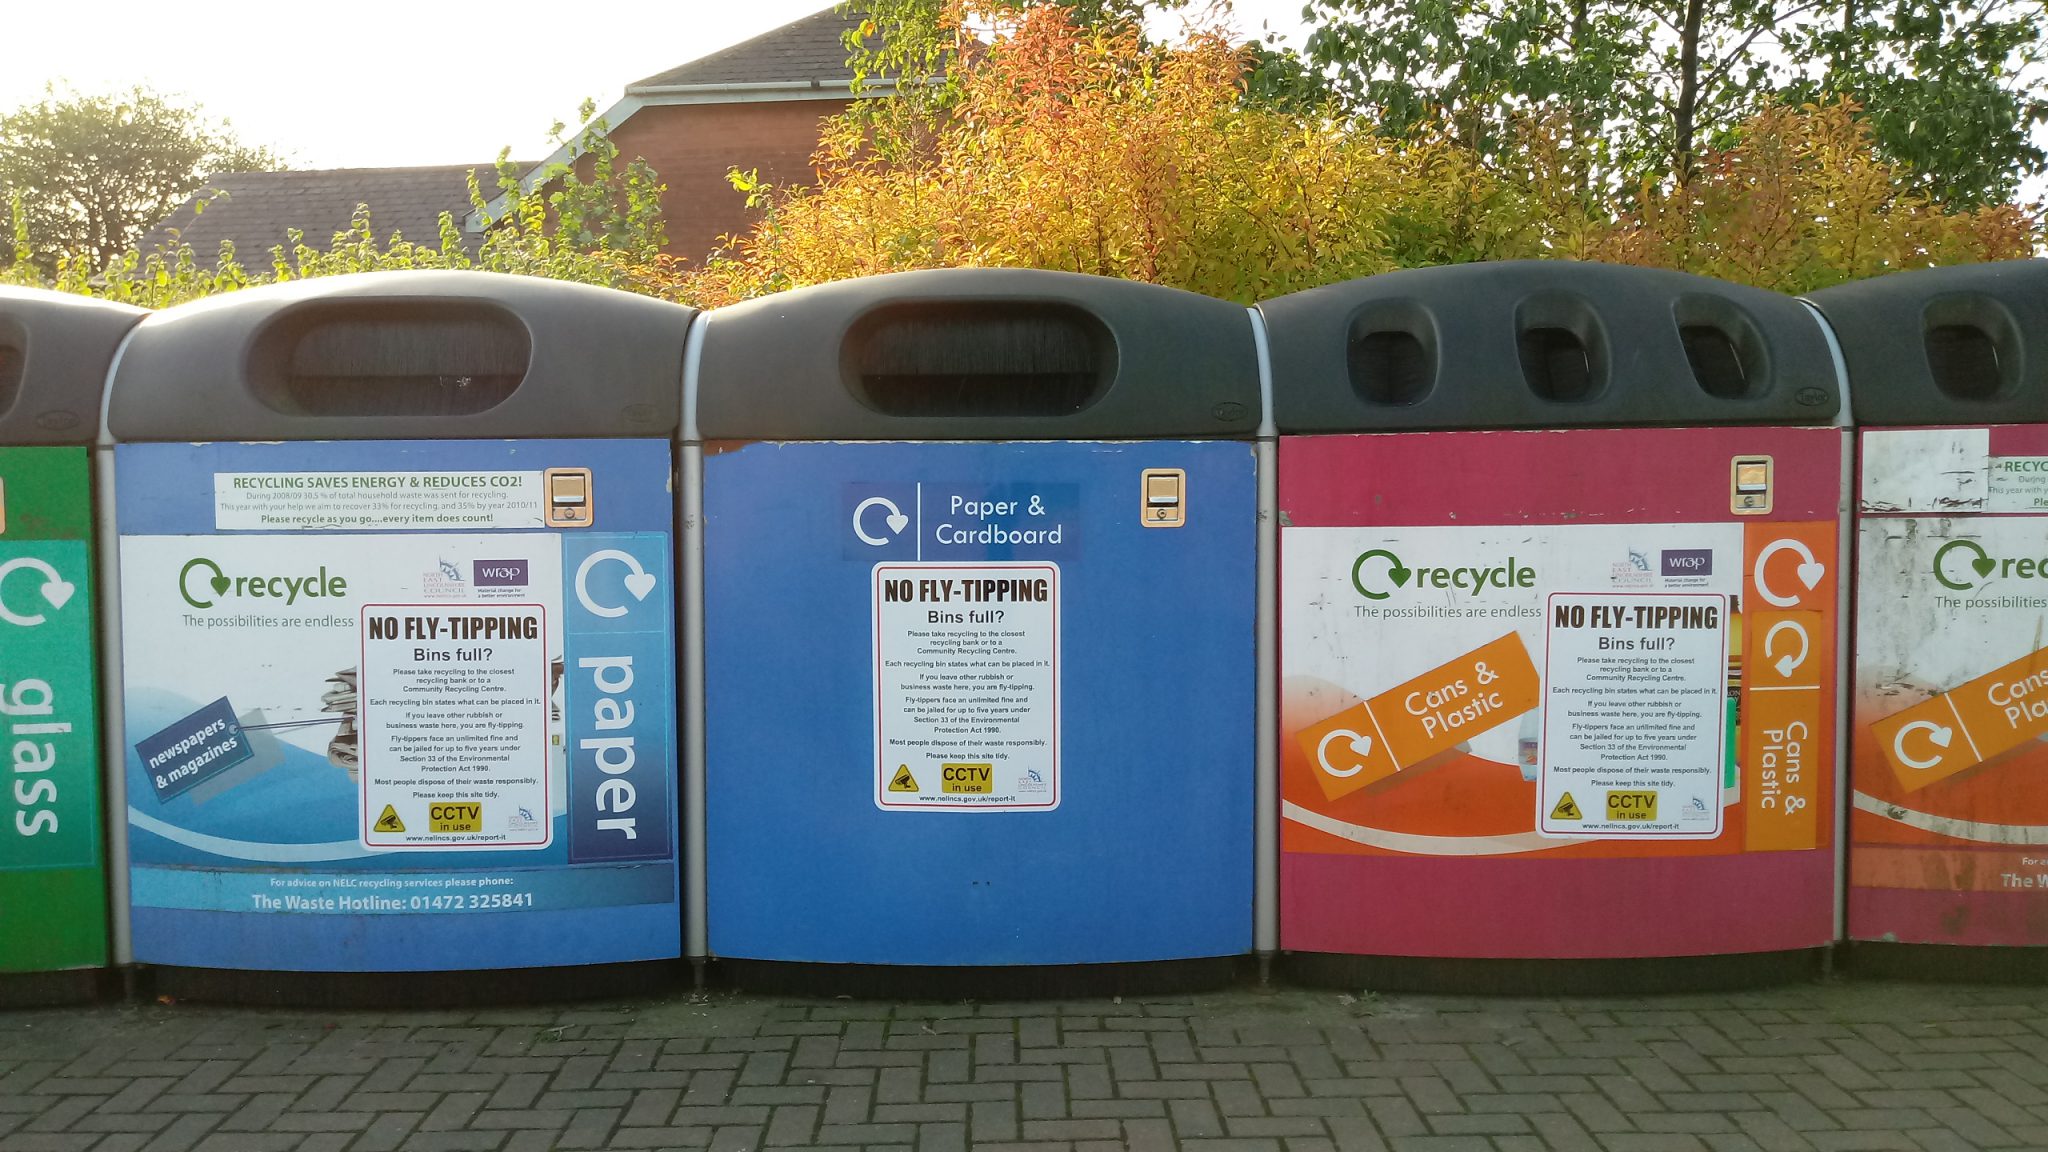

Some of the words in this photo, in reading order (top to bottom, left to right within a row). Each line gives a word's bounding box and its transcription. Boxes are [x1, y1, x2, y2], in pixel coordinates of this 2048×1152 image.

[233, 477, 304, 488] RECYCLING
[307, 477, 348, 488] SAVES
[352, 477, 406, 488] ENERGY
[409, 477, 420, 487] &
[423, 476, 486, 487] REDUCES
[490, 476, 522, 487] CO2!
[951, 496, 1018, 520] Paper
[1028, 495, 1046, 515] &
[261, 514, 290, 523] Please
[292, 514, 325, 525] recycle
[339, 517, 357, 525] you
[412, 514, 434, 522] item
[436, 513, 460, 522] does
[462, 514, 493, 522] count!
[936, 524, 1061, 544] Cardboard
[1669, 557, 1705, 570] wrap
[482, 567, 520, 580] wrap
[1417, 557, 1536, 596] recycle
[236, 566, 347, 606] recycle
[885, 580, 913, 602] NO
[919, 579, 1048, 602] FLY-TIPPING
[1936, 596, 1961, 607] The
[1965, 595, 2047, 610] possibilities
[928, 611, 964, 623] Bins
[969, 610, 1004, 623] full?
[1354, 606, 1379, 617] The
[1383, 605, 1462, 620] possibilities
[1466, 609, 1487, 617] are
[1490, 605, 1541, 617] endless
[1555, 606, 1585, 628] NO
[1591, 606, 1718, 629] FLY-TIPPING
[182, 614, 204, 626] The
[207, 614, 278, 629] possibilities
[281, 618, 301, 627] are
[304, 615, 354, 627] endless
[369, 617, 398, 640] NO
[405, 617, 538, 639] FLY-TIPPING
[1599, 637, 1634, 650] Bins
[1640, 637, 1675, 650] full?
[414, 648, 451, 661] Bins
[456, 648, 493, 661] full?
[445, 686, 479, 694] Recycling
[1405, 679, 1468, 716] Cans
[1475, 661, 1499, 685] &
[389, 699, 421, 707] recycling
[501, 698, 525, 706] placed
[1421, 692, 1504, 739] Plastic
[149, 718, 226, 769] newspapers
[578, 655, 637, 840] paper
[0, 678, 72, 837] glass
[1786, 720, 1808, 784] Cans
[156, 775, 169, 789] &
[167, 737, 238, 783] magazines
[1761, 729, 1784, 809] Plastic
[943, 768, 990, 781] CCTV
[952, 783, 961, 792] in
[1608, 795, 1656, 808] CCTV
[1785, 795, 1806, 816] &
[431, 806, 479, 820] CCTV
[1616, 811, 1626, 819] in
[270, 878, 286, 886] For
[287, 879, 317, 887] advice
[333, 879, 357, 887] NELC
[359, 879, 402, 889] recycling
[404, 879, 443, 887] services
[445, 878, 477, 888] please
[478, 877, 514, 887] phone:
[2001, 873, 2033, 888] The
[252, 894, 282, 909] The
[285, 896, 335, 910] Waste
[339, 896, 406, 910] Hotline:
[410, 895, 464, 909] 01472
[469, 893, 532, 908] 325841
